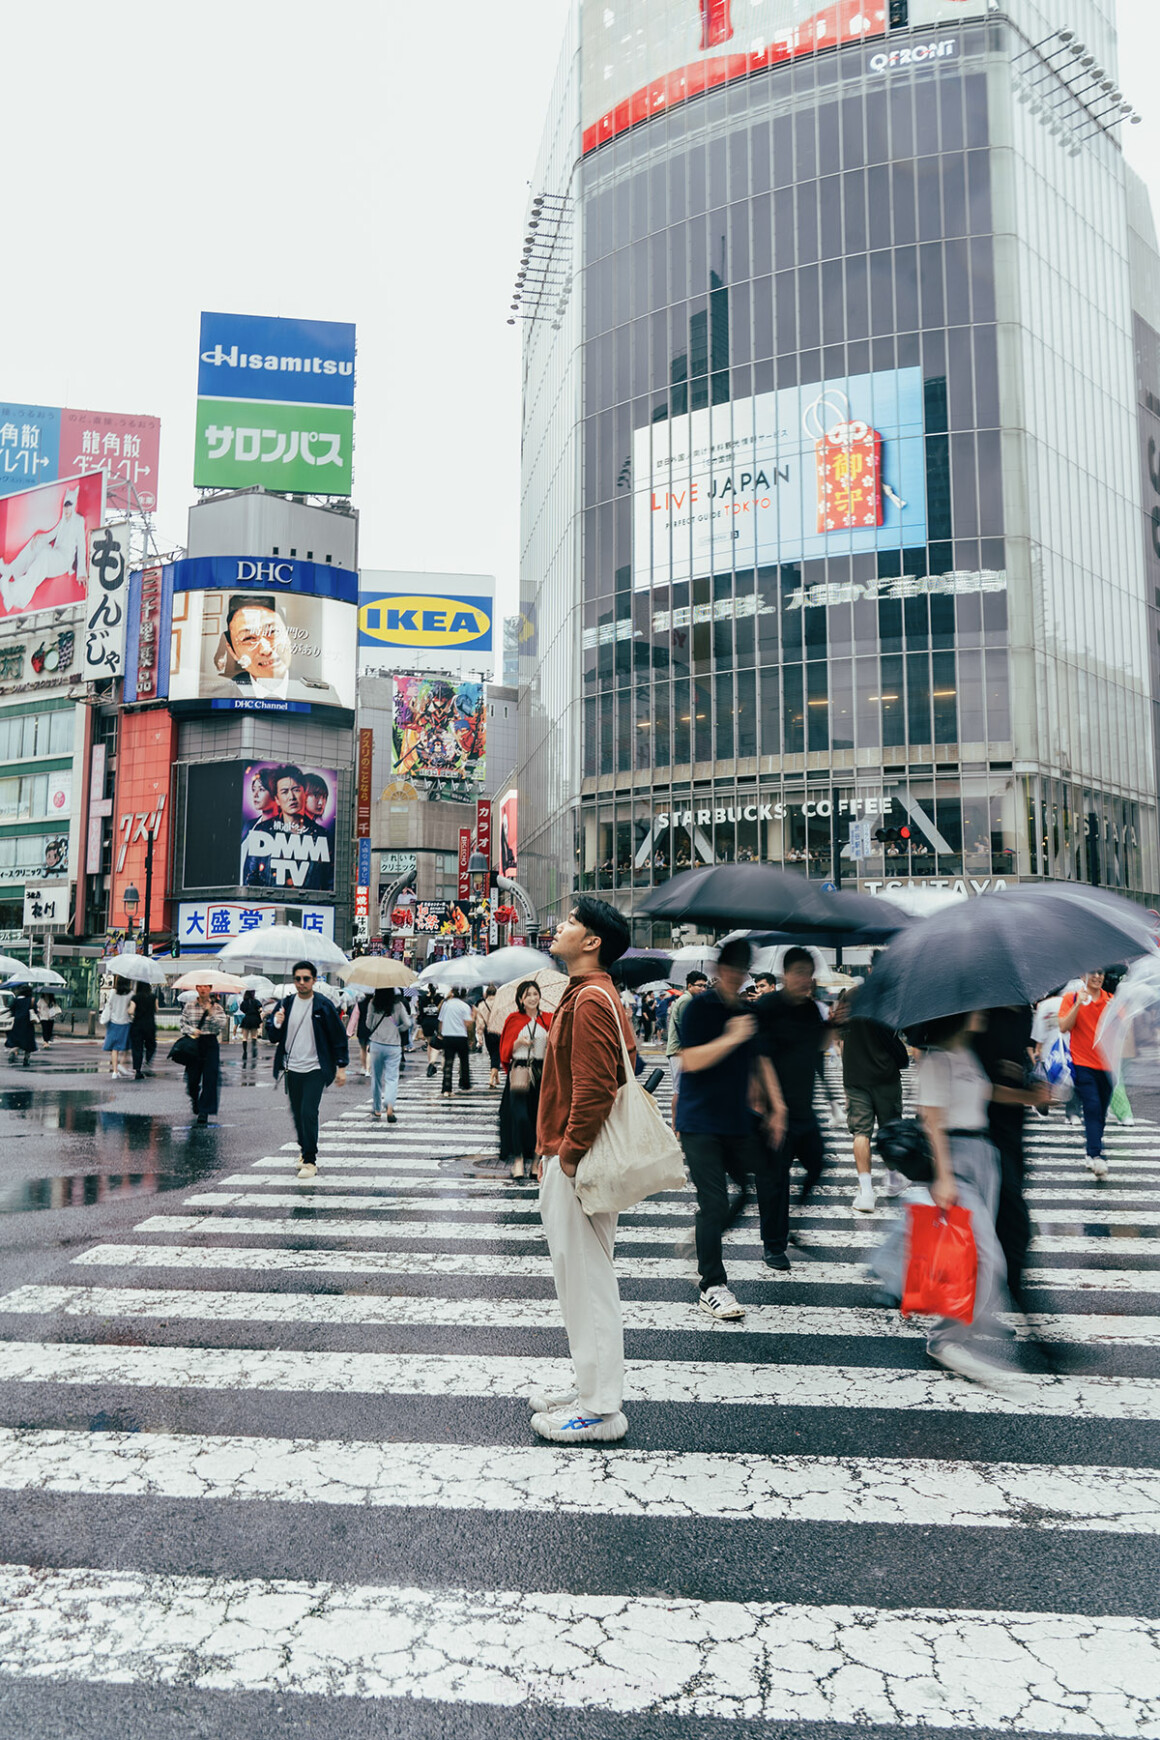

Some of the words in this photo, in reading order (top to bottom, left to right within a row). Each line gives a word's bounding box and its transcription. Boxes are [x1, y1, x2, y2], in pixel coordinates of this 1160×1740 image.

[870, 39, 956, 73] QFRONT
[201, 345, 353, 376] Hisamitsu
[82, 429, 141, 458] 龍角散
[205, 425, 343, 467] サロンパス
[651, 484, 698, 511] LIVE
[707, 465, 789, 499] JAPAN
[832, 453, 863, 514] 御守
[724, 498, 771, 516] TOKYO
[236, 561, 294, 584] DHC
[86, 529, 125, 673] もんじゃ
[367, 608, 480, 633] IKEA
[235, 700, 254, 709] DHC
[255, 701, 288, 710] Channel
[658, 803, 787, 829] STARBUCKS
[802, 797, 893, 817] COFFEE
[116, 793, 167, 873] クスリ
[478, 807, 489, 858] カラオ
[1073, 812, 1137, 847] TSTAYA
[247, 830, 330, 862] DMM
[270, 859, 309, 886] TV
[381, 864, 416, 872] クリニック
[460, 871, 469, 900] カラ
[186, 909, 324, 935] 大盛堂店
